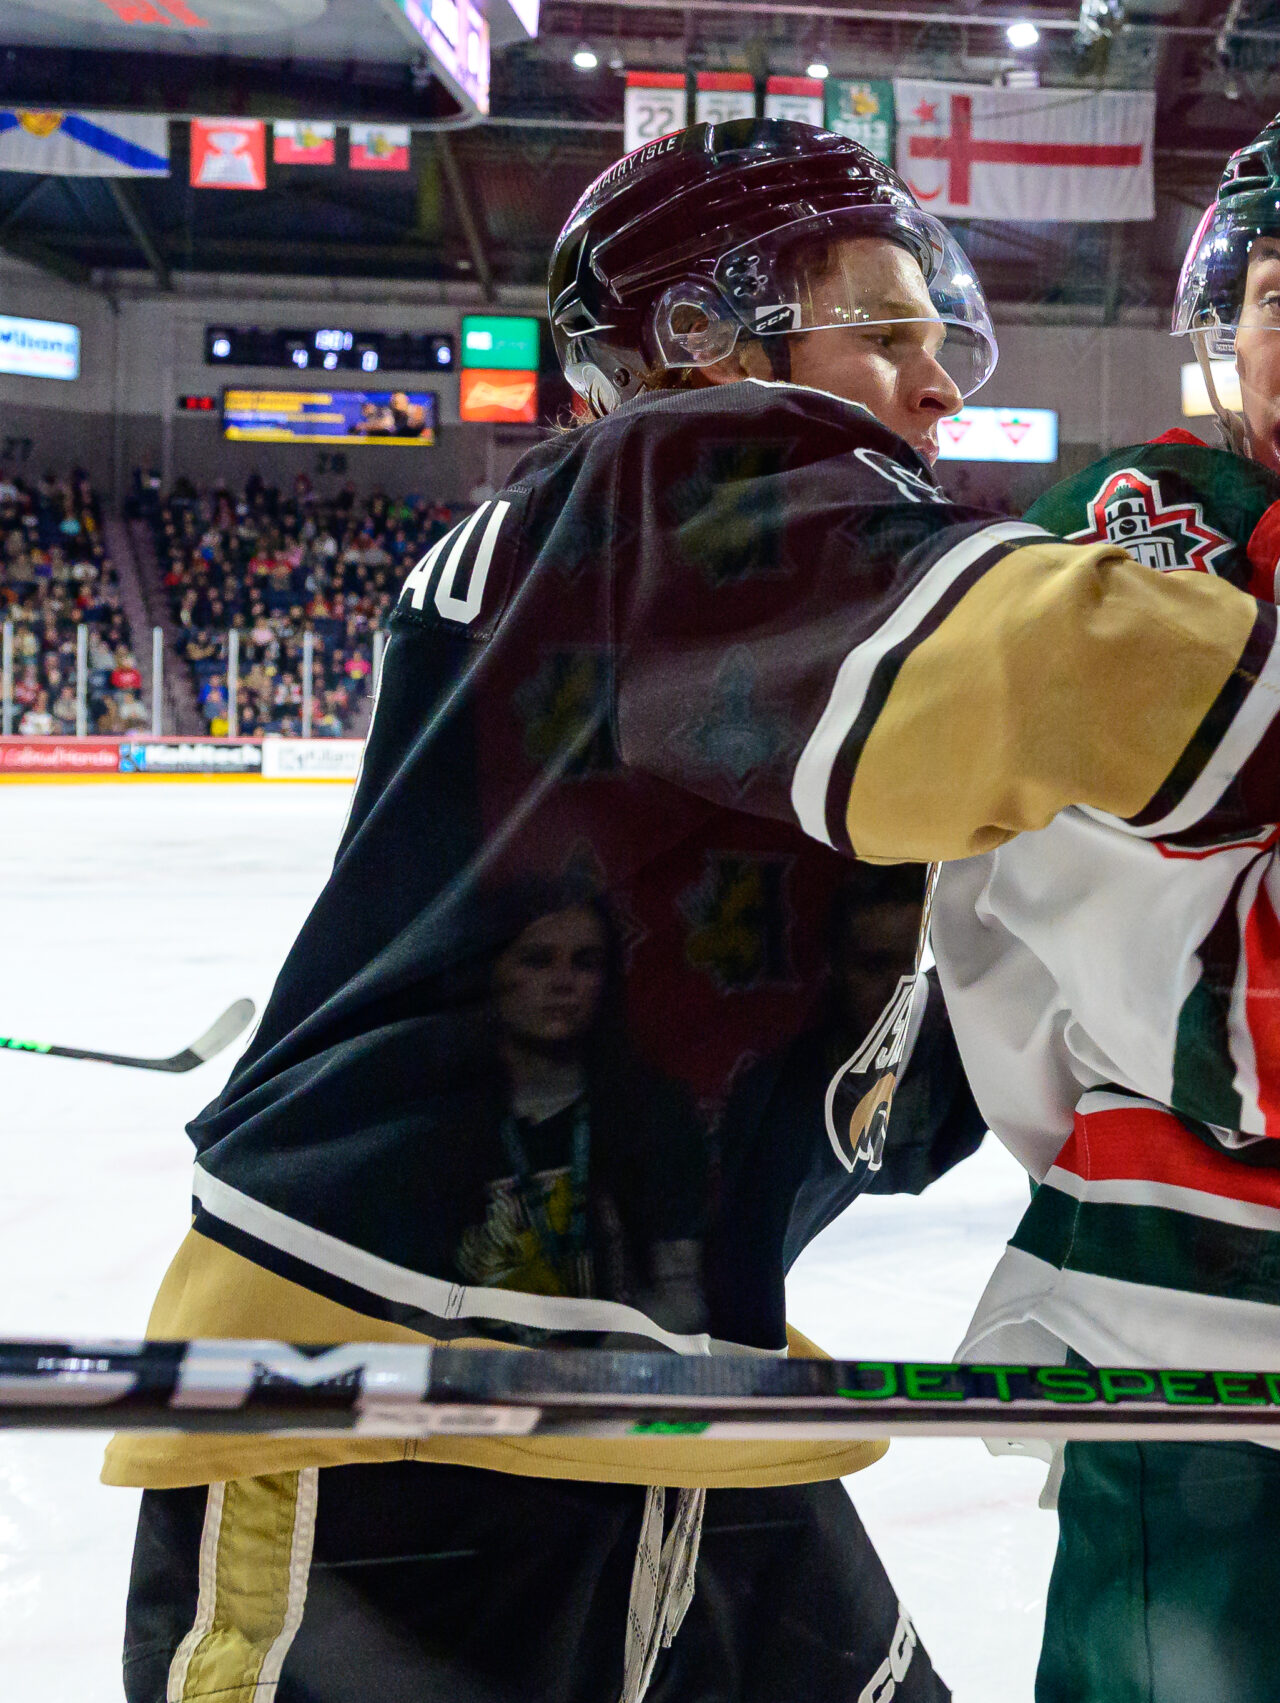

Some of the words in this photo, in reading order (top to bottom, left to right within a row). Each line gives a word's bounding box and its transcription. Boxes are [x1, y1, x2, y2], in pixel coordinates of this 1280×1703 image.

[638, 105, 674, 140] 22
[640, 136, 678, 163] ISLE
[756, 309, 791, 332] CCM
